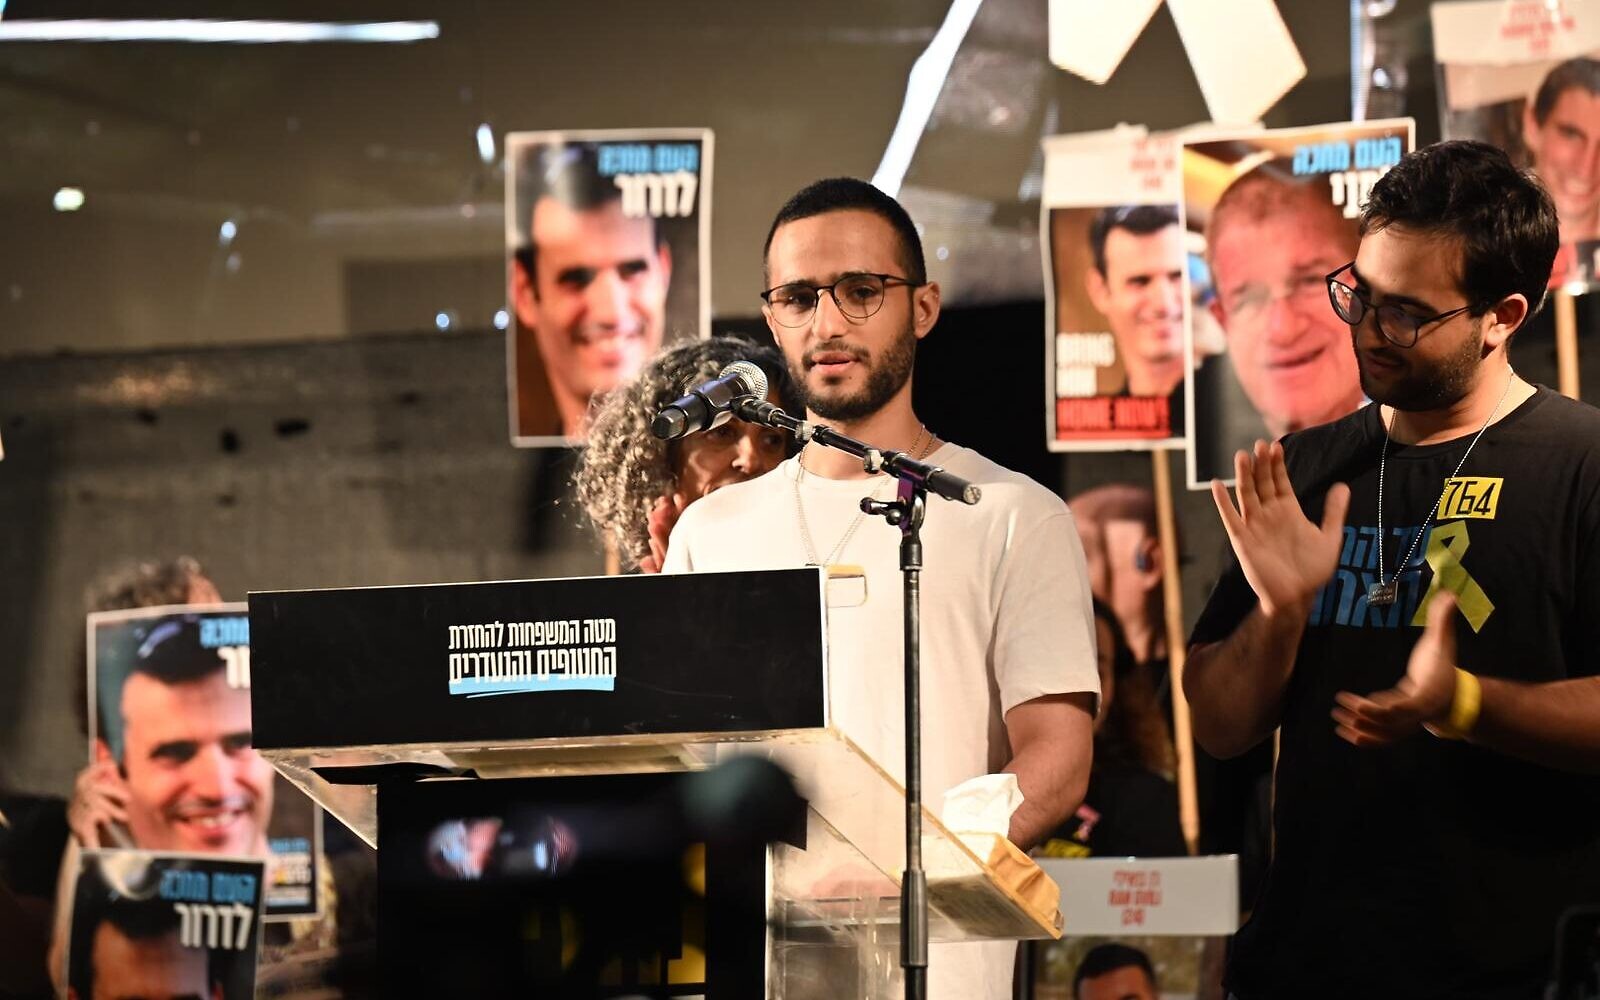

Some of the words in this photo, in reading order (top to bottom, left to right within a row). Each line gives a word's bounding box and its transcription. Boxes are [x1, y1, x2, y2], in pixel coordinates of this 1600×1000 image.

[1293, 142, 1350, 176] מחכה
[1355, 136, 1402, 171] העם
[613, 168, 698, 218] לדרור
[1056, 332, 1115, 367] BRING
[1056, 366, 1097, 397] HIM
[1057, 398, 1110, 429] HOME
[1444, 481, 1496, 516] 764
[448, 620, 504, 650] להחזרת
[507, 619, 580, 647] המשפחות
[583, 618, 616, 643] מטה
[448, 650, 532, 684] והנעדרים
[536, 646, 617, 681] החטופים
[173, 901, 254, 950] לדרור
